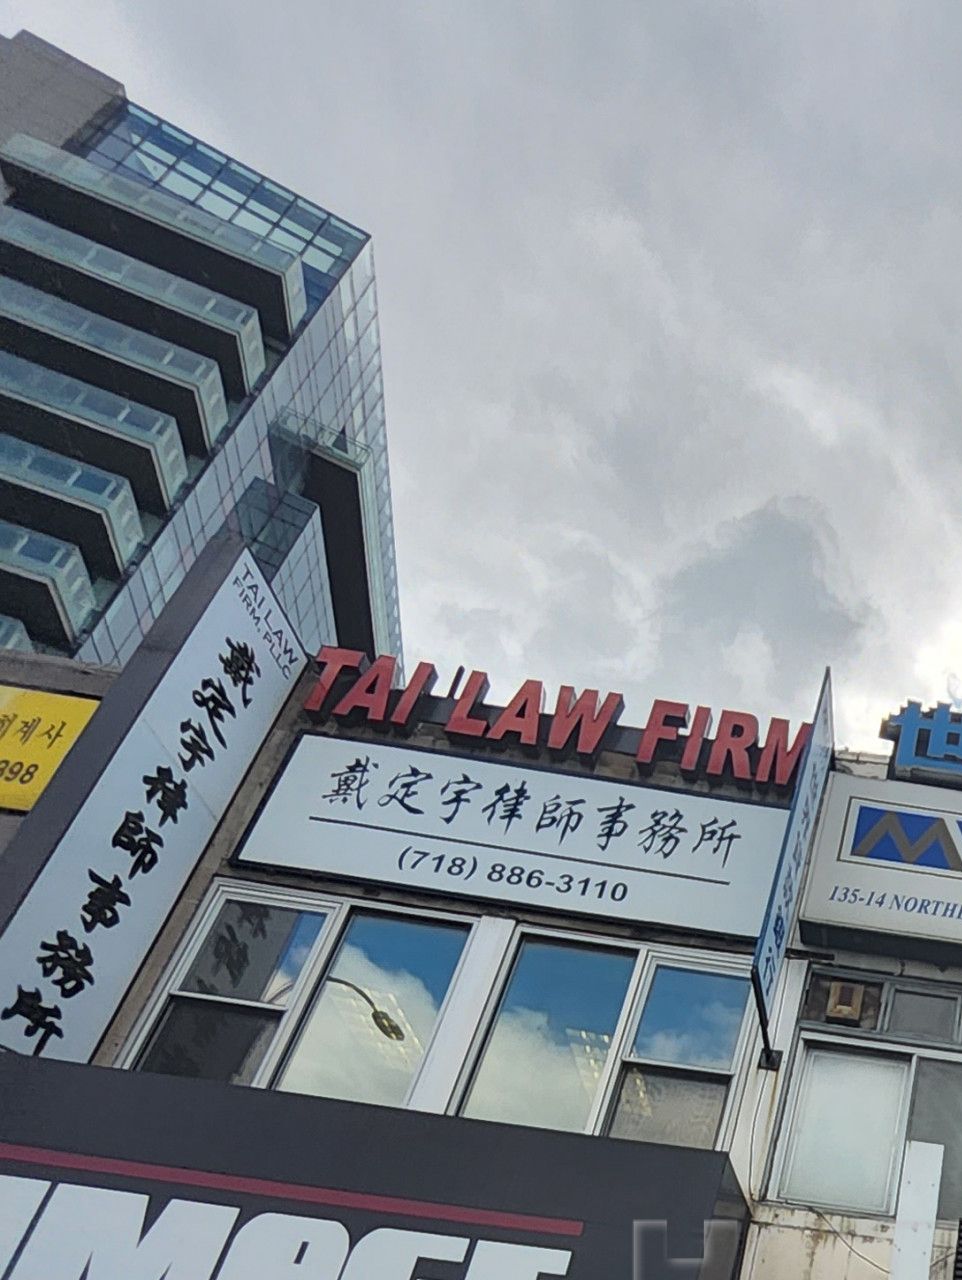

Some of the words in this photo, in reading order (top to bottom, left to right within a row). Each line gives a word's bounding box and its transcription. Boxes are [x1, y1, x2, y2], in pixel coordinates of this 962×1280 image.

[242, 562, 266, 608] TAI
[264, 609, 299, 665] LAW
[262, 631, 292, 680] PLLC
[302, 646, 436, 725] TAI
[445, 671, 624, 753] LAW
[637, 699, 814, 785] FIRM
[321, 755, 742, 868] 戴定宇律師事務所
[397, 847, 478, 881] (718)
[487, 862, 629, 903] 886-3110
[828, 886, 887, 909] 135-14
